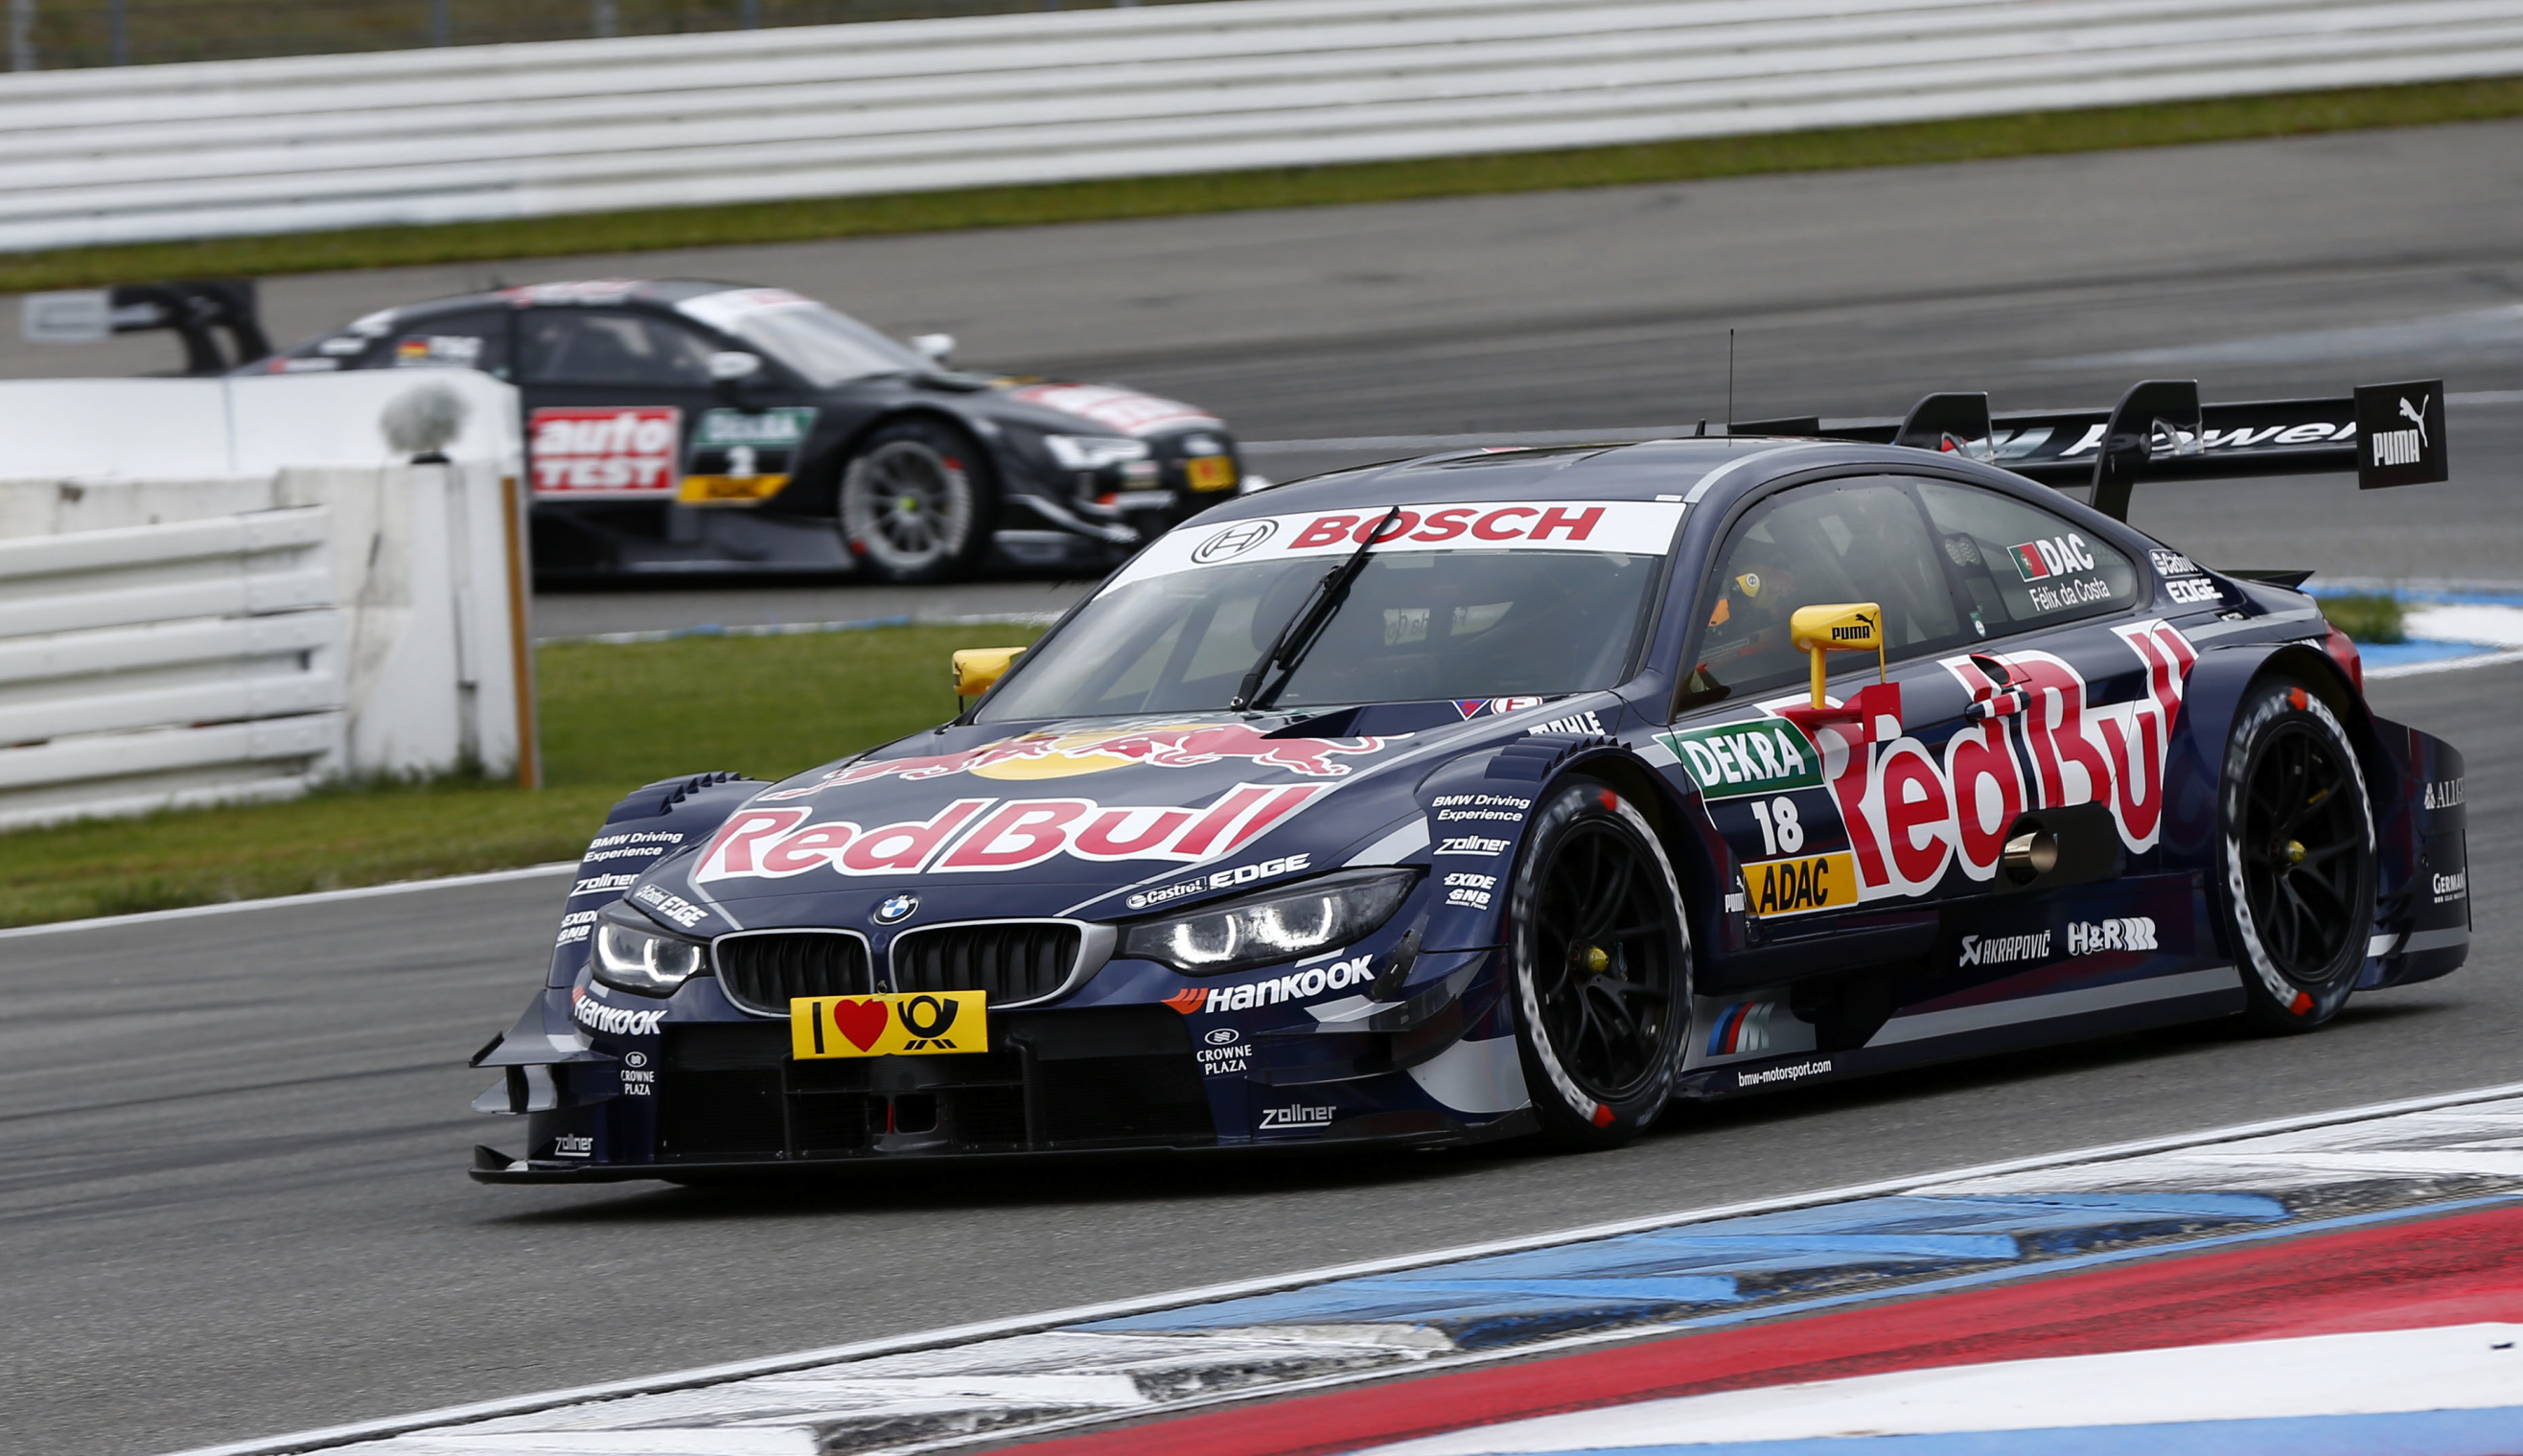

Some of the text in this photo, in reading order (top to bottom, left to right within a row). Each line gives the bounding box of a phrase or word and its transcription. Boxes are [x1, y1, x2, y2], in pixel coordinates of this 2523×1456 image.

[533, 414, 669, 455] auto
[2372, 428, 2421, 468] PUMA
[534, 455, 663, 487] TEST
[1286, 507, 1607, 550] BOSCH
[2035, 533, 2095, 577] DAC
[2028, 575, 2111, 612] Félix da Costa
[2165, 577, 2224, 605] EDGE
[1832, 625, 1870, 640] PUMA
[1681, 728, 1806, 788] DEKRA
[1432, 795, 1531, 809] BMW Driving
[1437, 808, 1523, 821] Experience
[589, 831, 684, 849] BMW Driving
[1750, 796, 1804, 856] 18
[582, 846, 663, 863] Experience
[1210, 852, 1311, 890] EDGE
[1444, 873, 1497, 890] EXIDE
[1146, 881, 1204, 903] Castrol
[1448, 889, 1492, 904] GNB
[1759, 857, 1829, 914] ADAC
[656, 895, 709, 929] EDGE
[2068, 918, 2123, 956] H&R
[1196, 1045, 1252, 1063] CROWNE
[1205, 1059, 1247, 1075] PLAZA
[620, 1070, 655, 1083] CROWNE
[1738, 1059, 1832, 1087] bmw-motorsport.com
[624, 1083, 651, 1096] PLAZA
